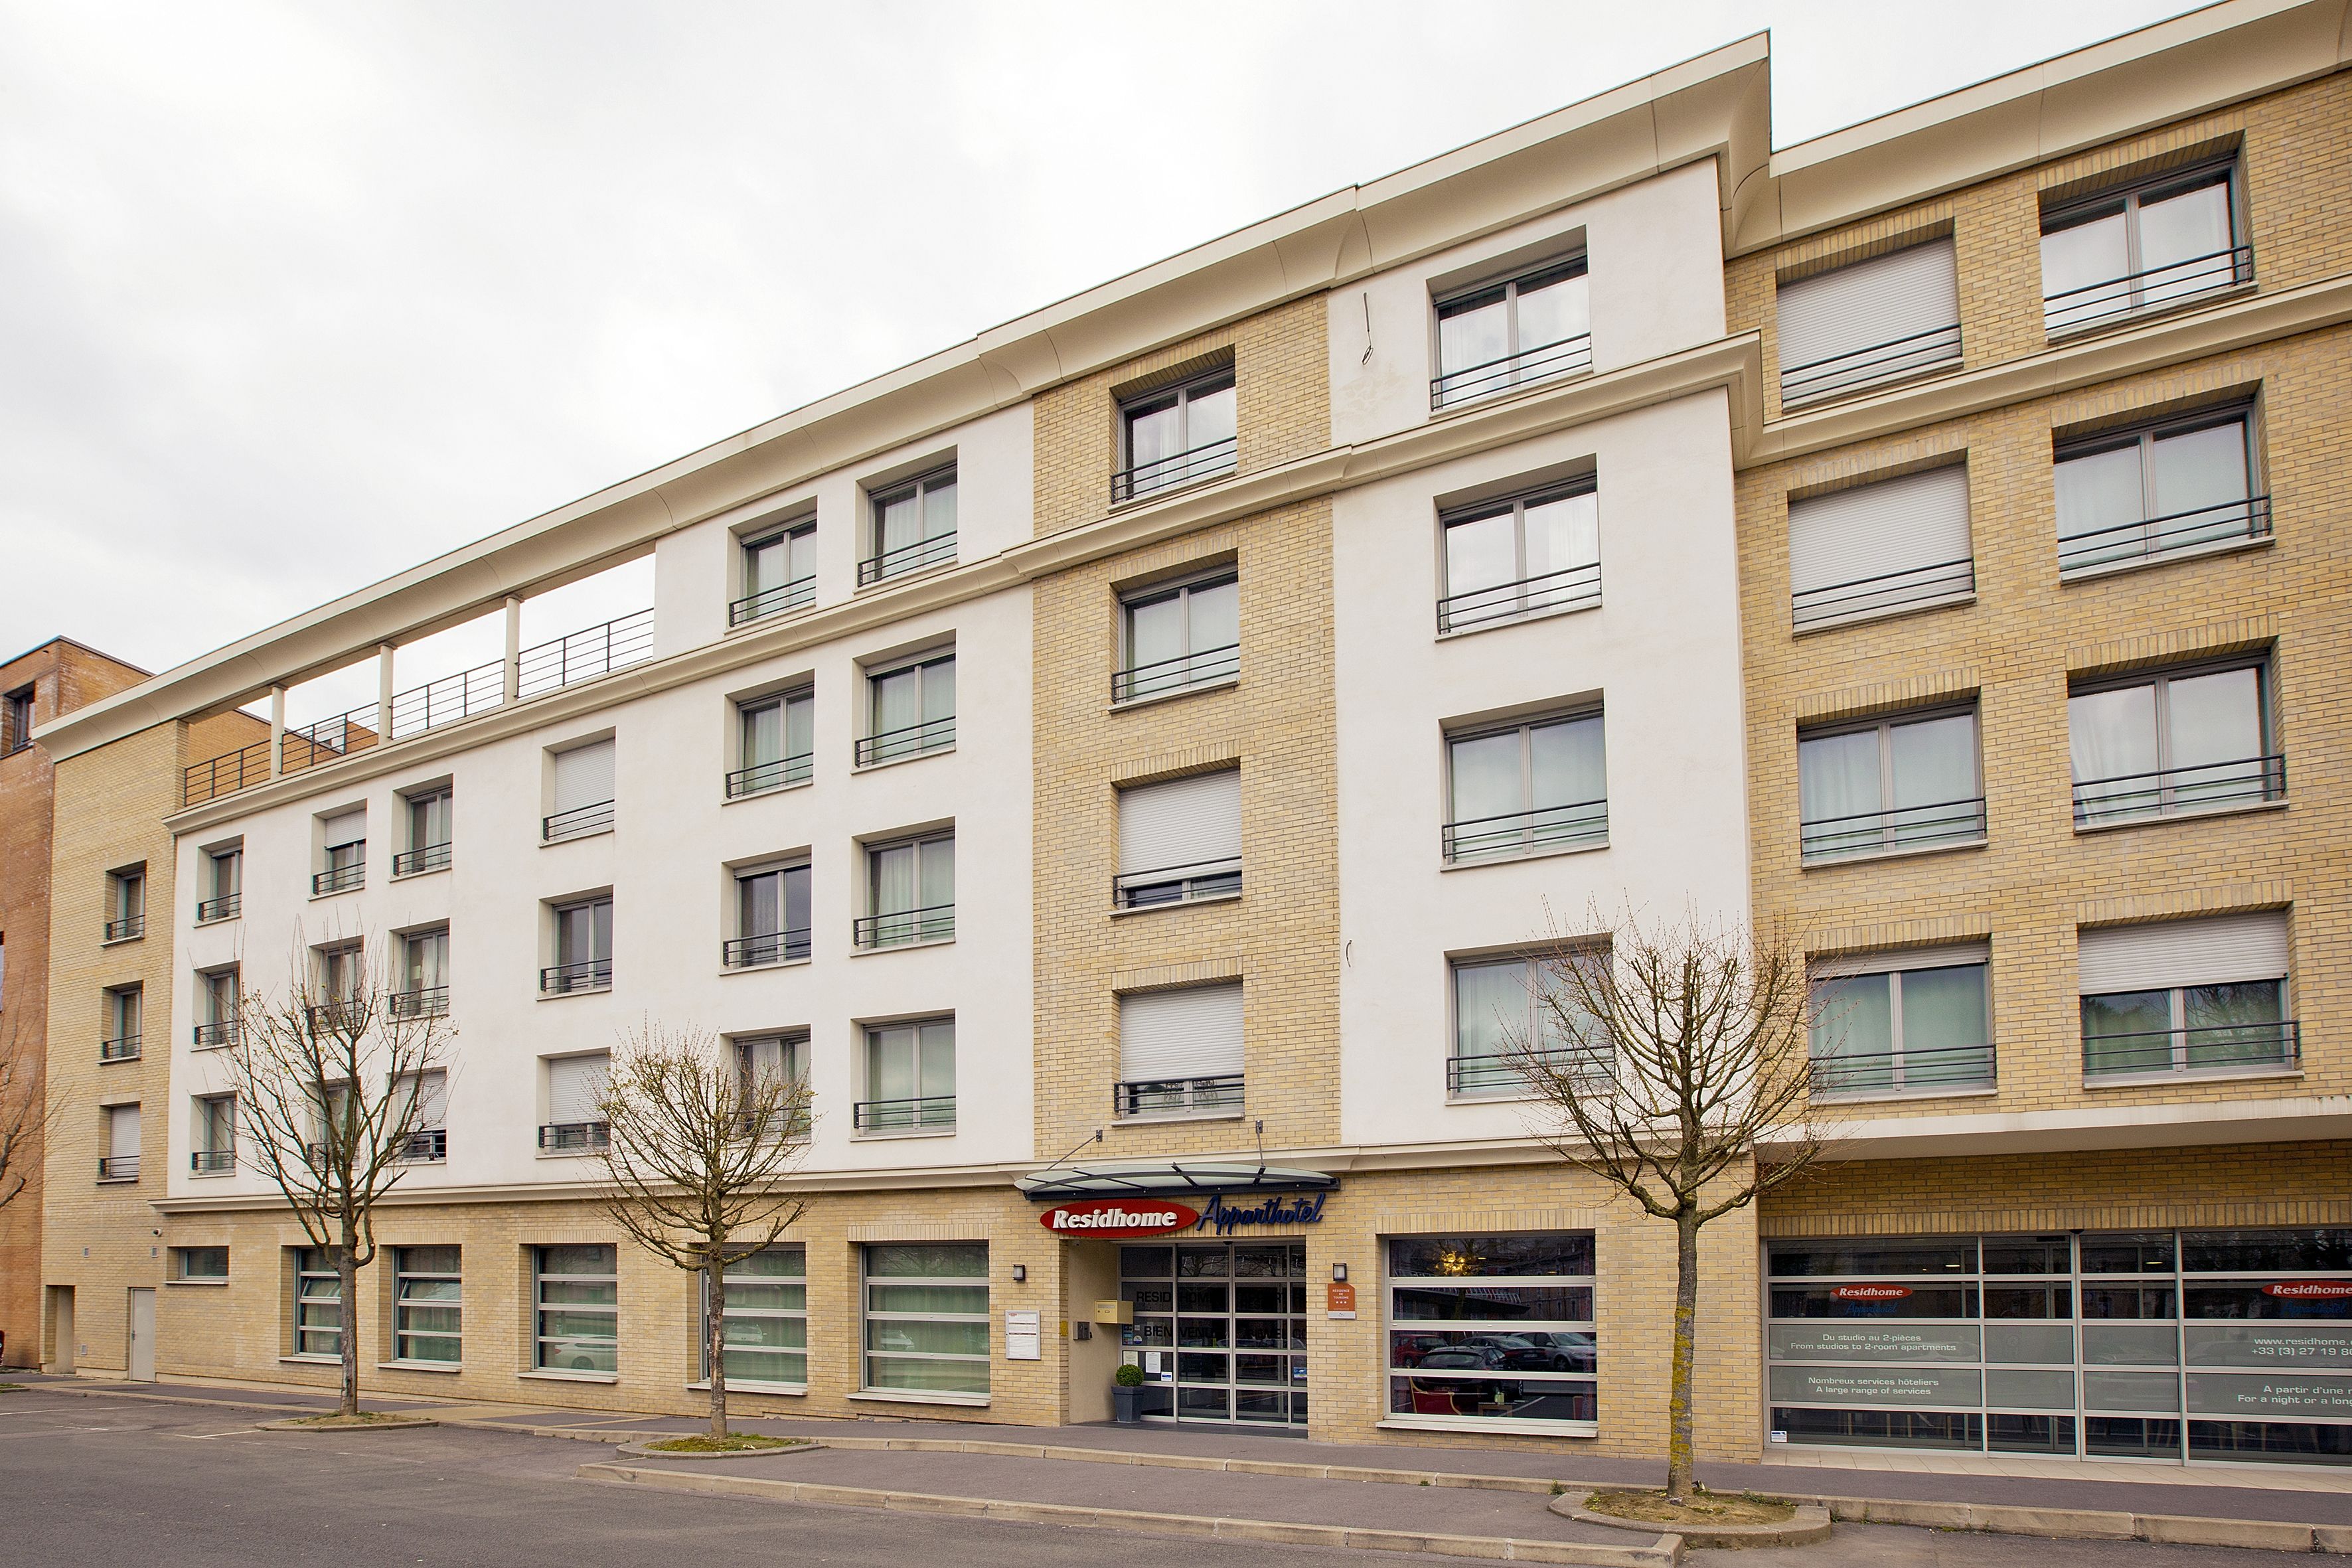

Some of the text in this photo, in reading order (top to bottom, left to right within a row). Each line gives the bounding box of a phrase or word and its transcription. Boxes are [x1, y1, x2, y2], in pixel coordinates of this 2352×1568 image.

[1052, 1192, 1326, 1235] Residhome Apparthotel
[2273, 1285, 2352, 1294] Residhome
[2278, 1347, 2295, 1356] (3)
[2272, 1396, 2300, 1405] night
